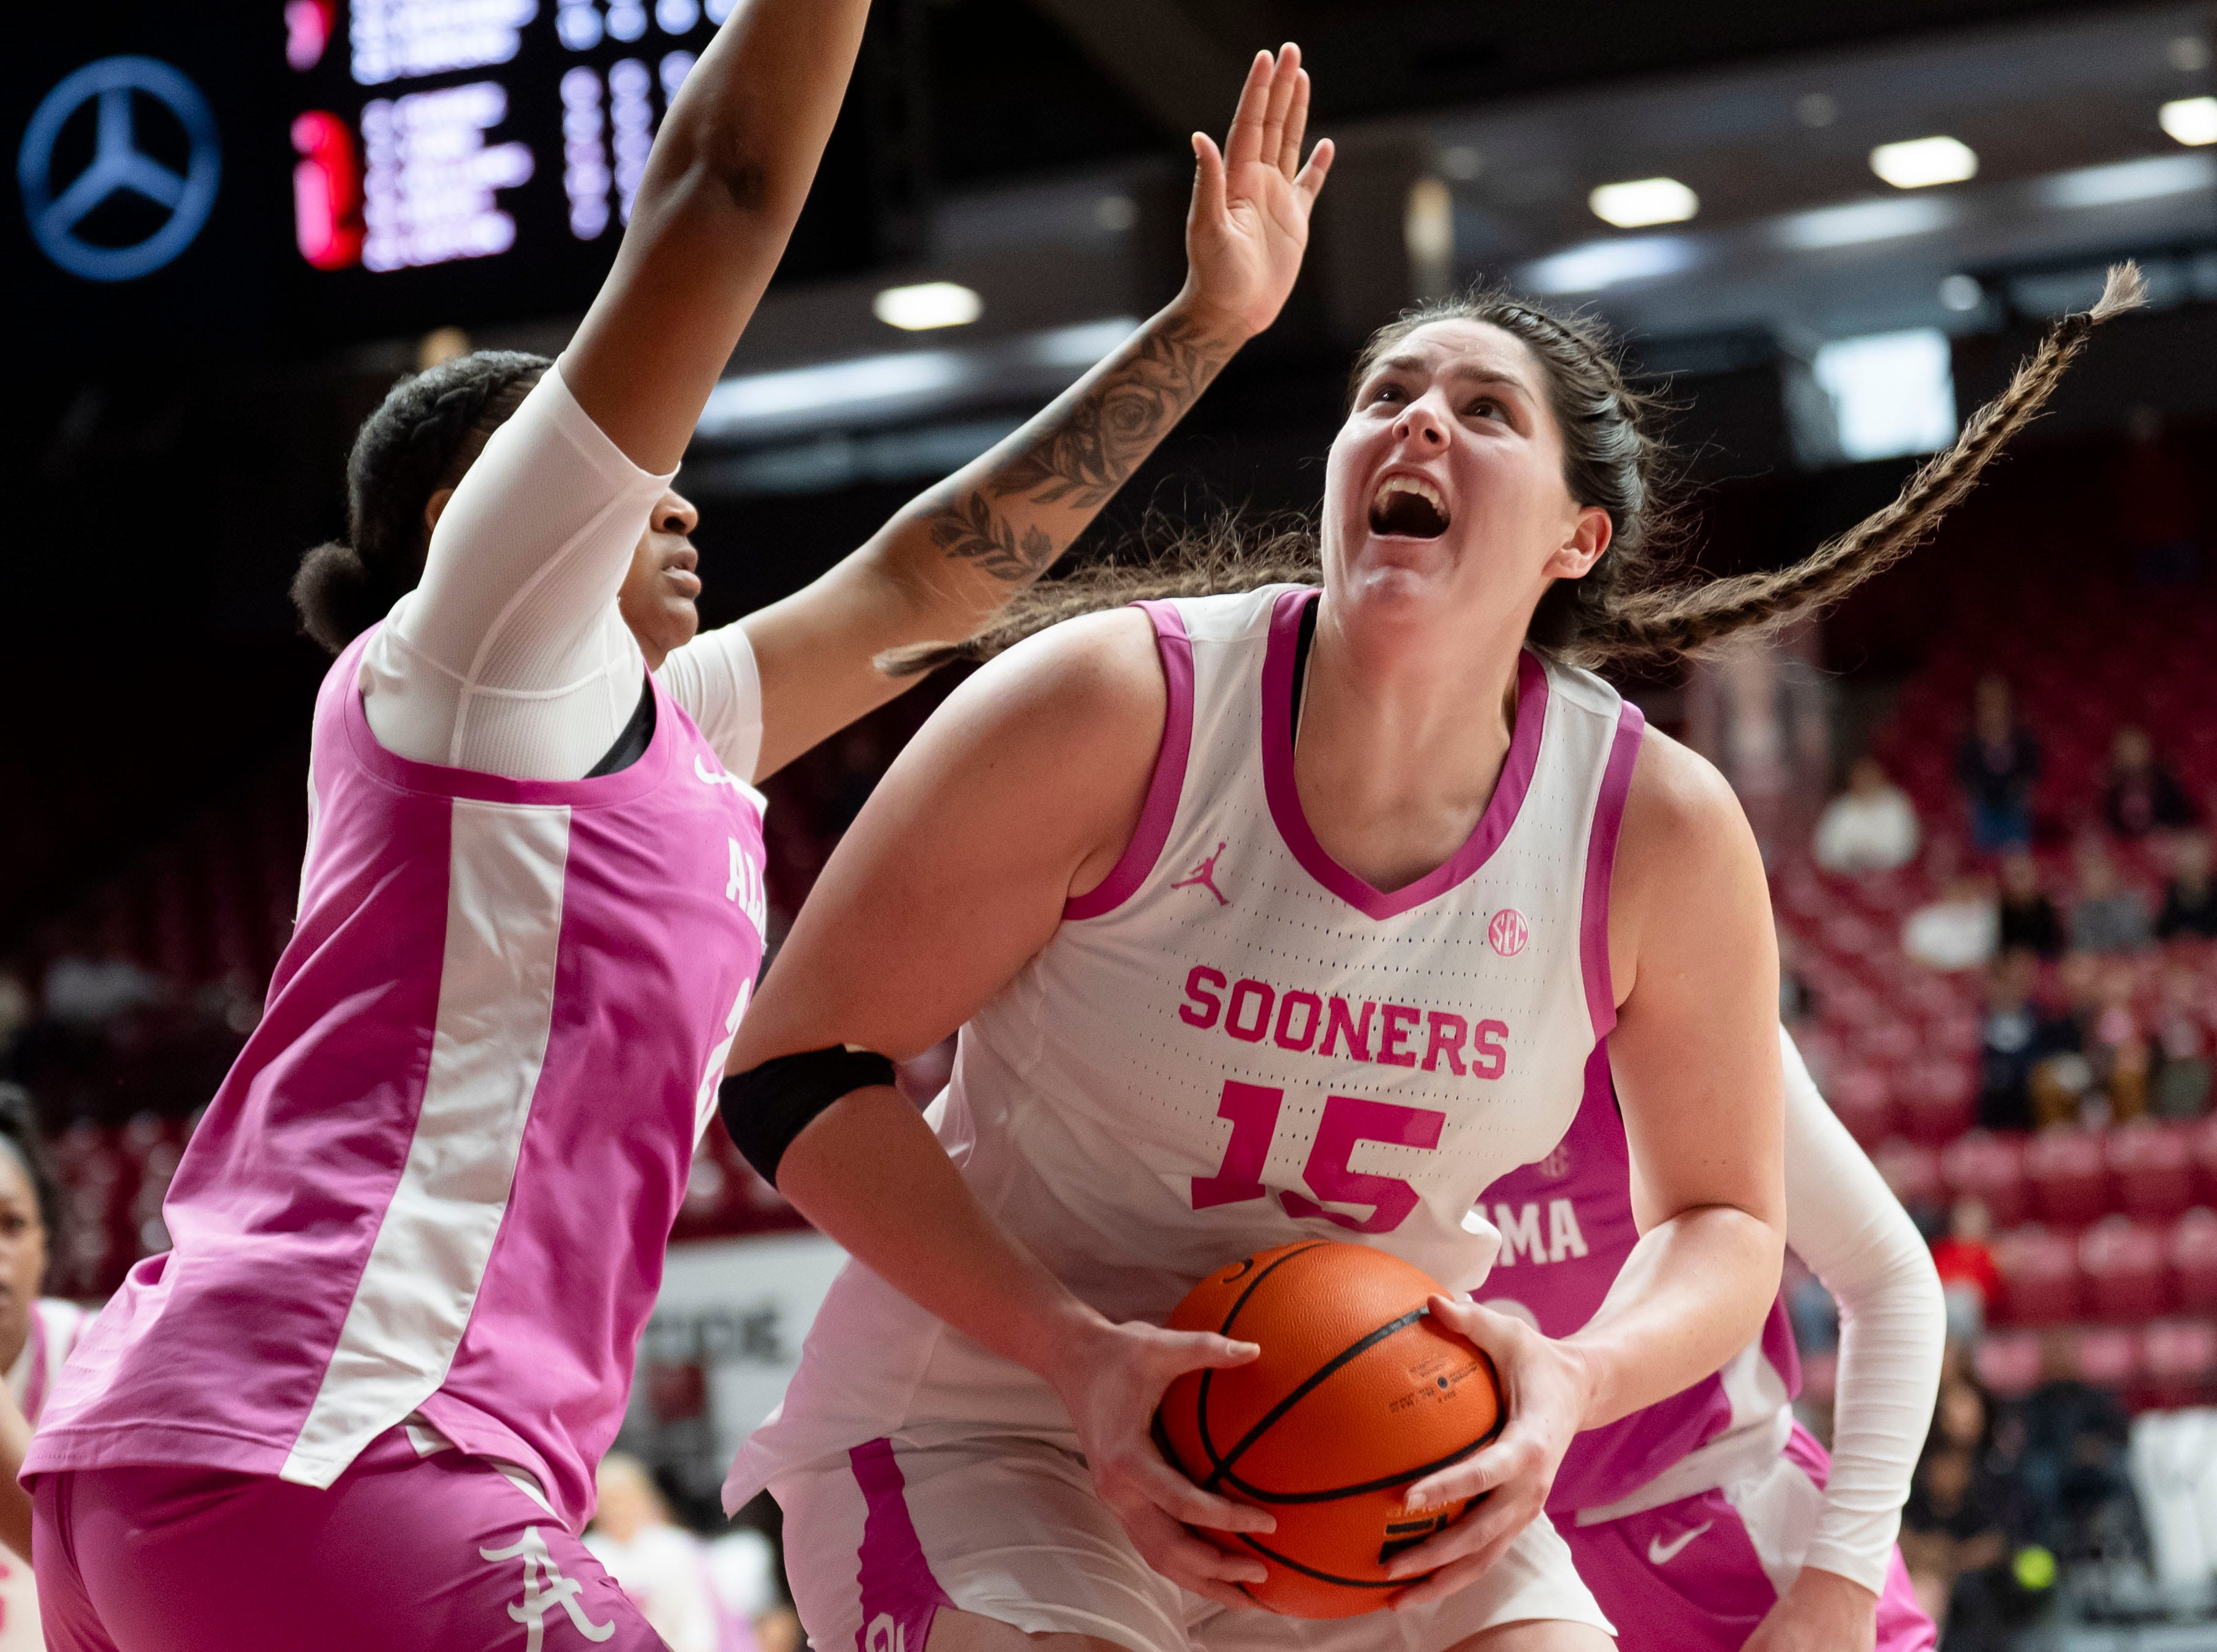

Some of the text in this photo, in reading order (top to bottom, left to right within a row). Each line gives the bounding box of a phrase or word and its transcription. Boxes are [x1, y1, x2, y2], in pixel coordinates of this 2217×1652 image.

[1492, 912, 1527, 954] SEC
[1178, 964, 1510, 1081] SOONERS
[1191, 1079, 1447, 1234] 15
[1472, 1198, 1589, 1268] MA
